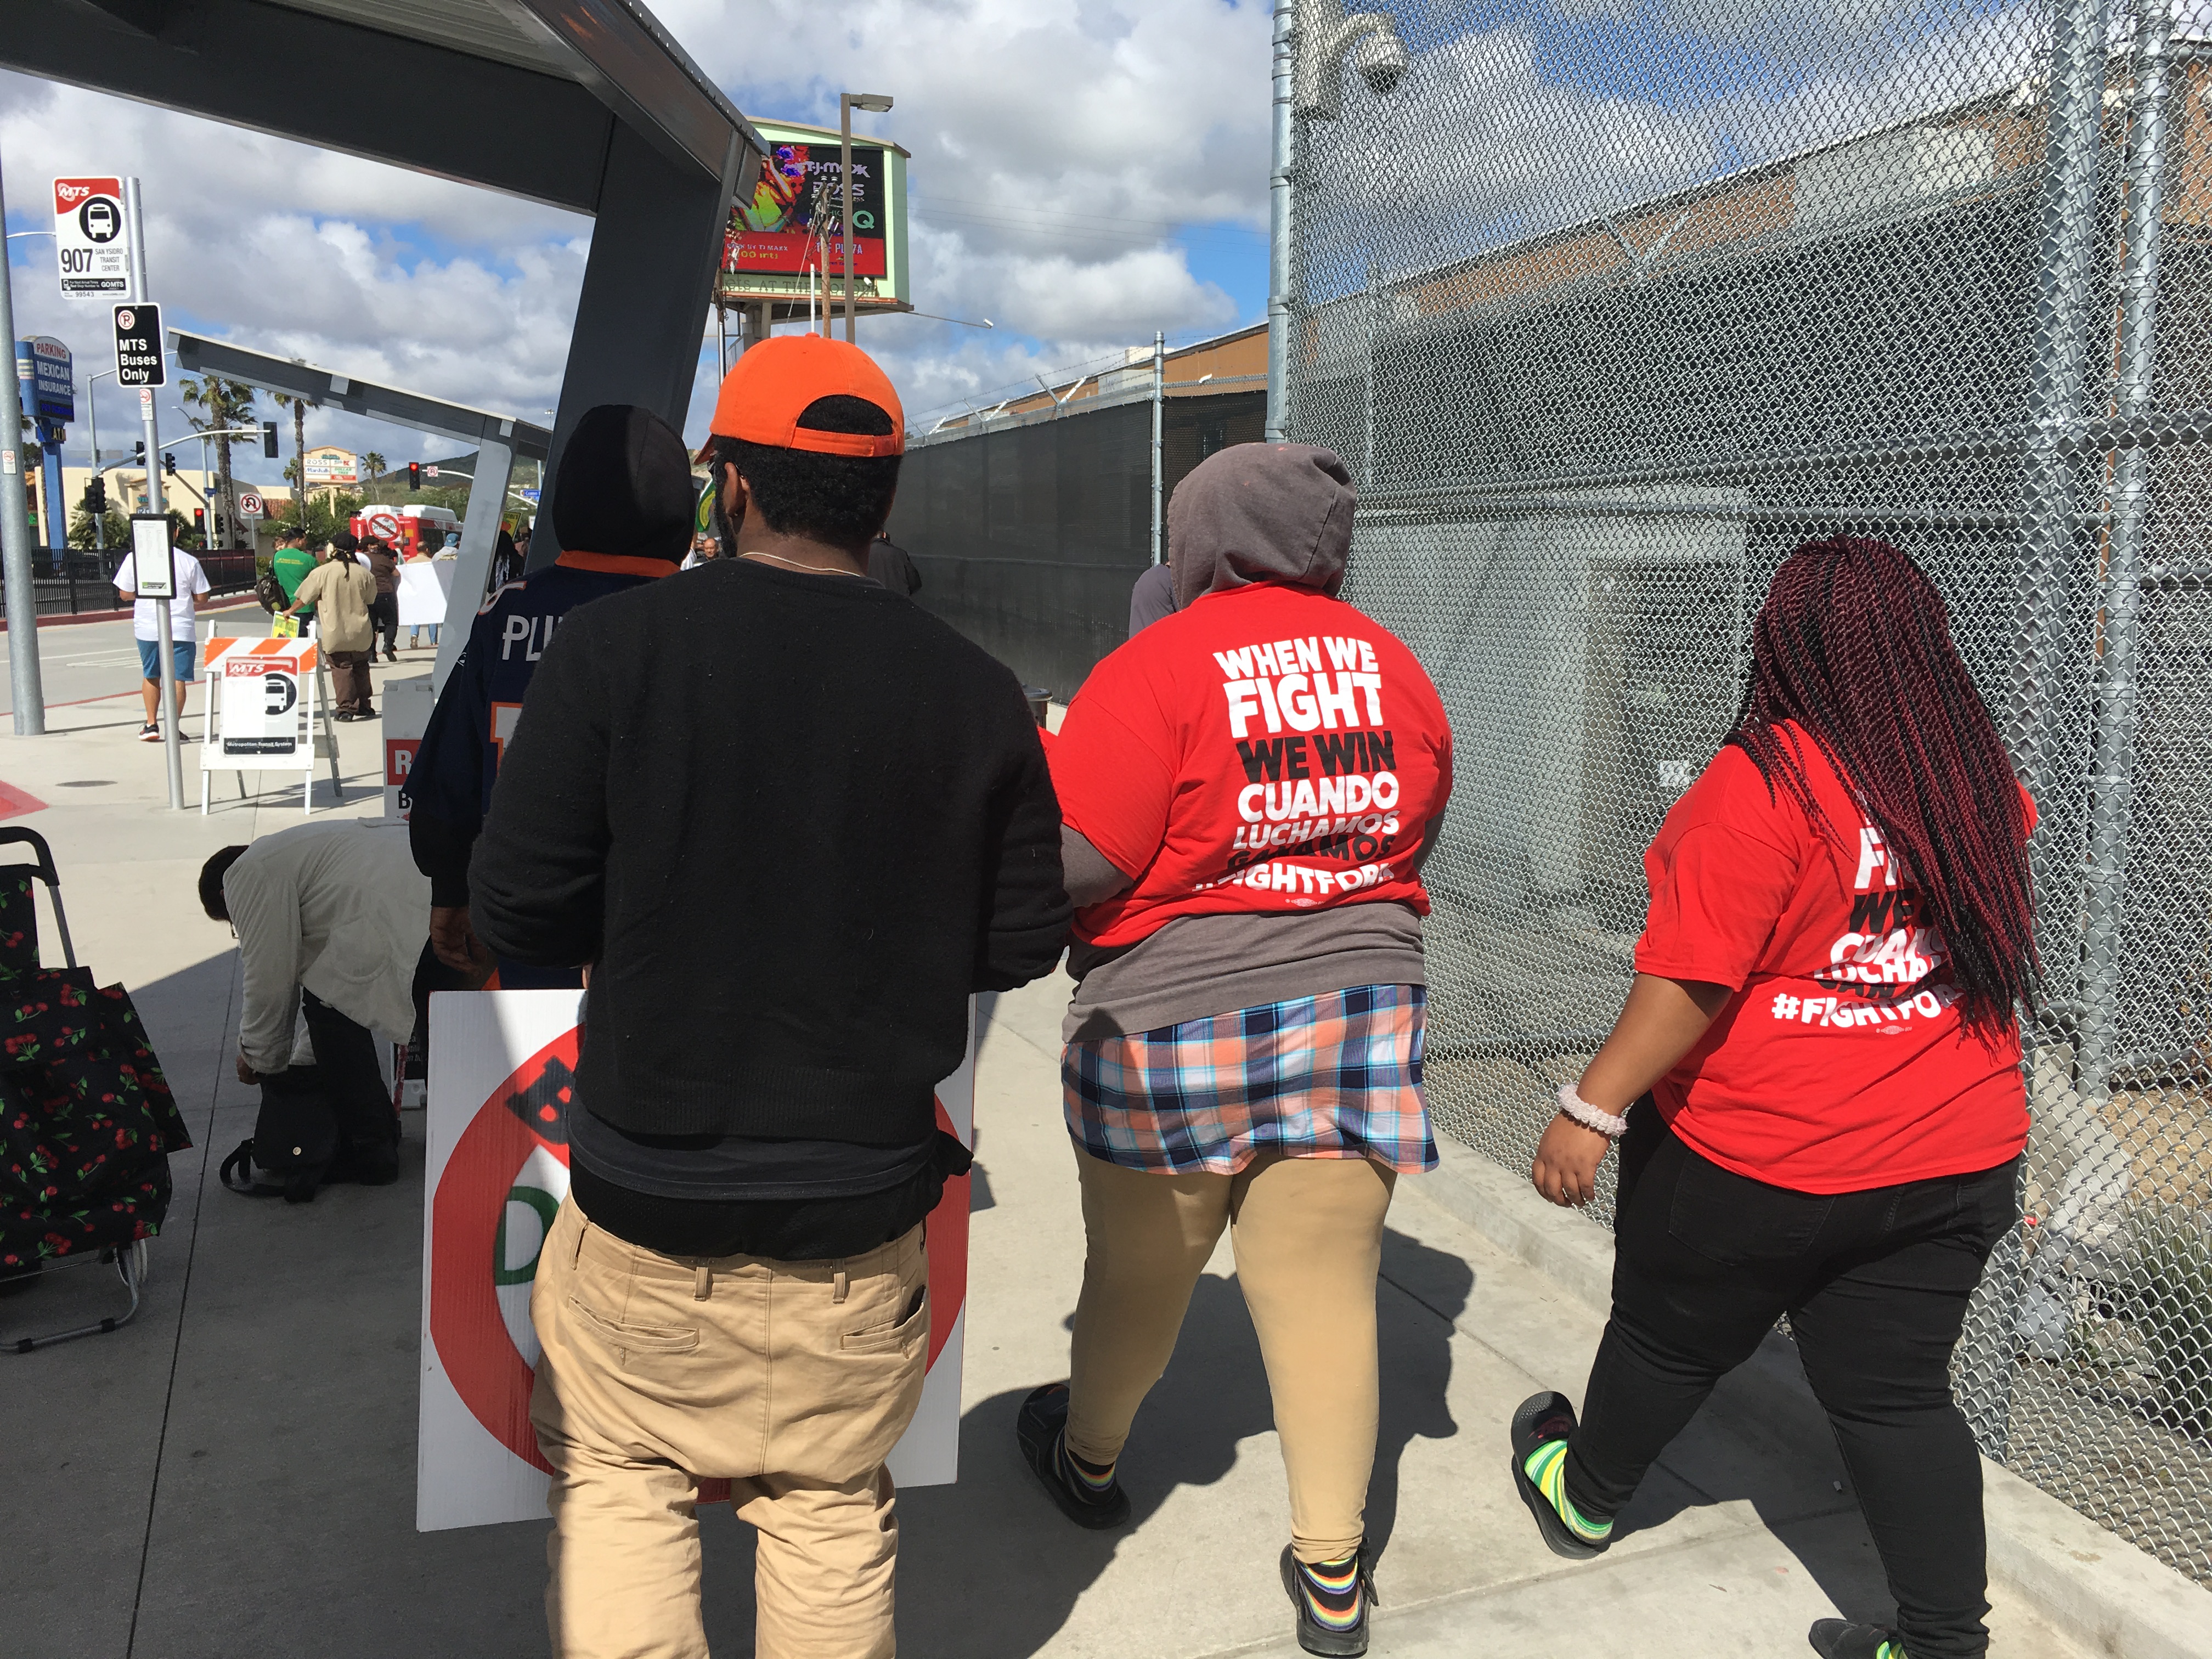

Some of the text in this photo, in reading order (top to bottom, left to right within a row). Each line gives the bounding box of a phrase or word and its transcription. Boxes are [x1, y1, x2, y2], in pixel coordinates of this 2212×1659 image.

[58, 187, 90, 196] MTS
[853, 210, 874, 229] Q
[816, 241, 863, 255] TE PLZA
[61, 248, 93, 273] 907
[759, 280, 777, 292] AT
[36, 343, 66, 359] PARKING
[119, 338, 148, 351] MTS
[120, 354, 157, 366] Buses
[37, 360, 70, 381] MEXICAN
[122, 368, 149, 383] Only
[38, 379, 71, 396] INSURANCE
[1212, 636, 1379, 680] WHEN WE
[229, 664, 265, 673] MTS
[1223, 671, 1383, 738] FIGHT
[1235, 730, 1397, 783] WE WIN
[1237, 771, 1400, 823] CUANDO
[1232, 810, 1400, 850] LUCHAMOS
